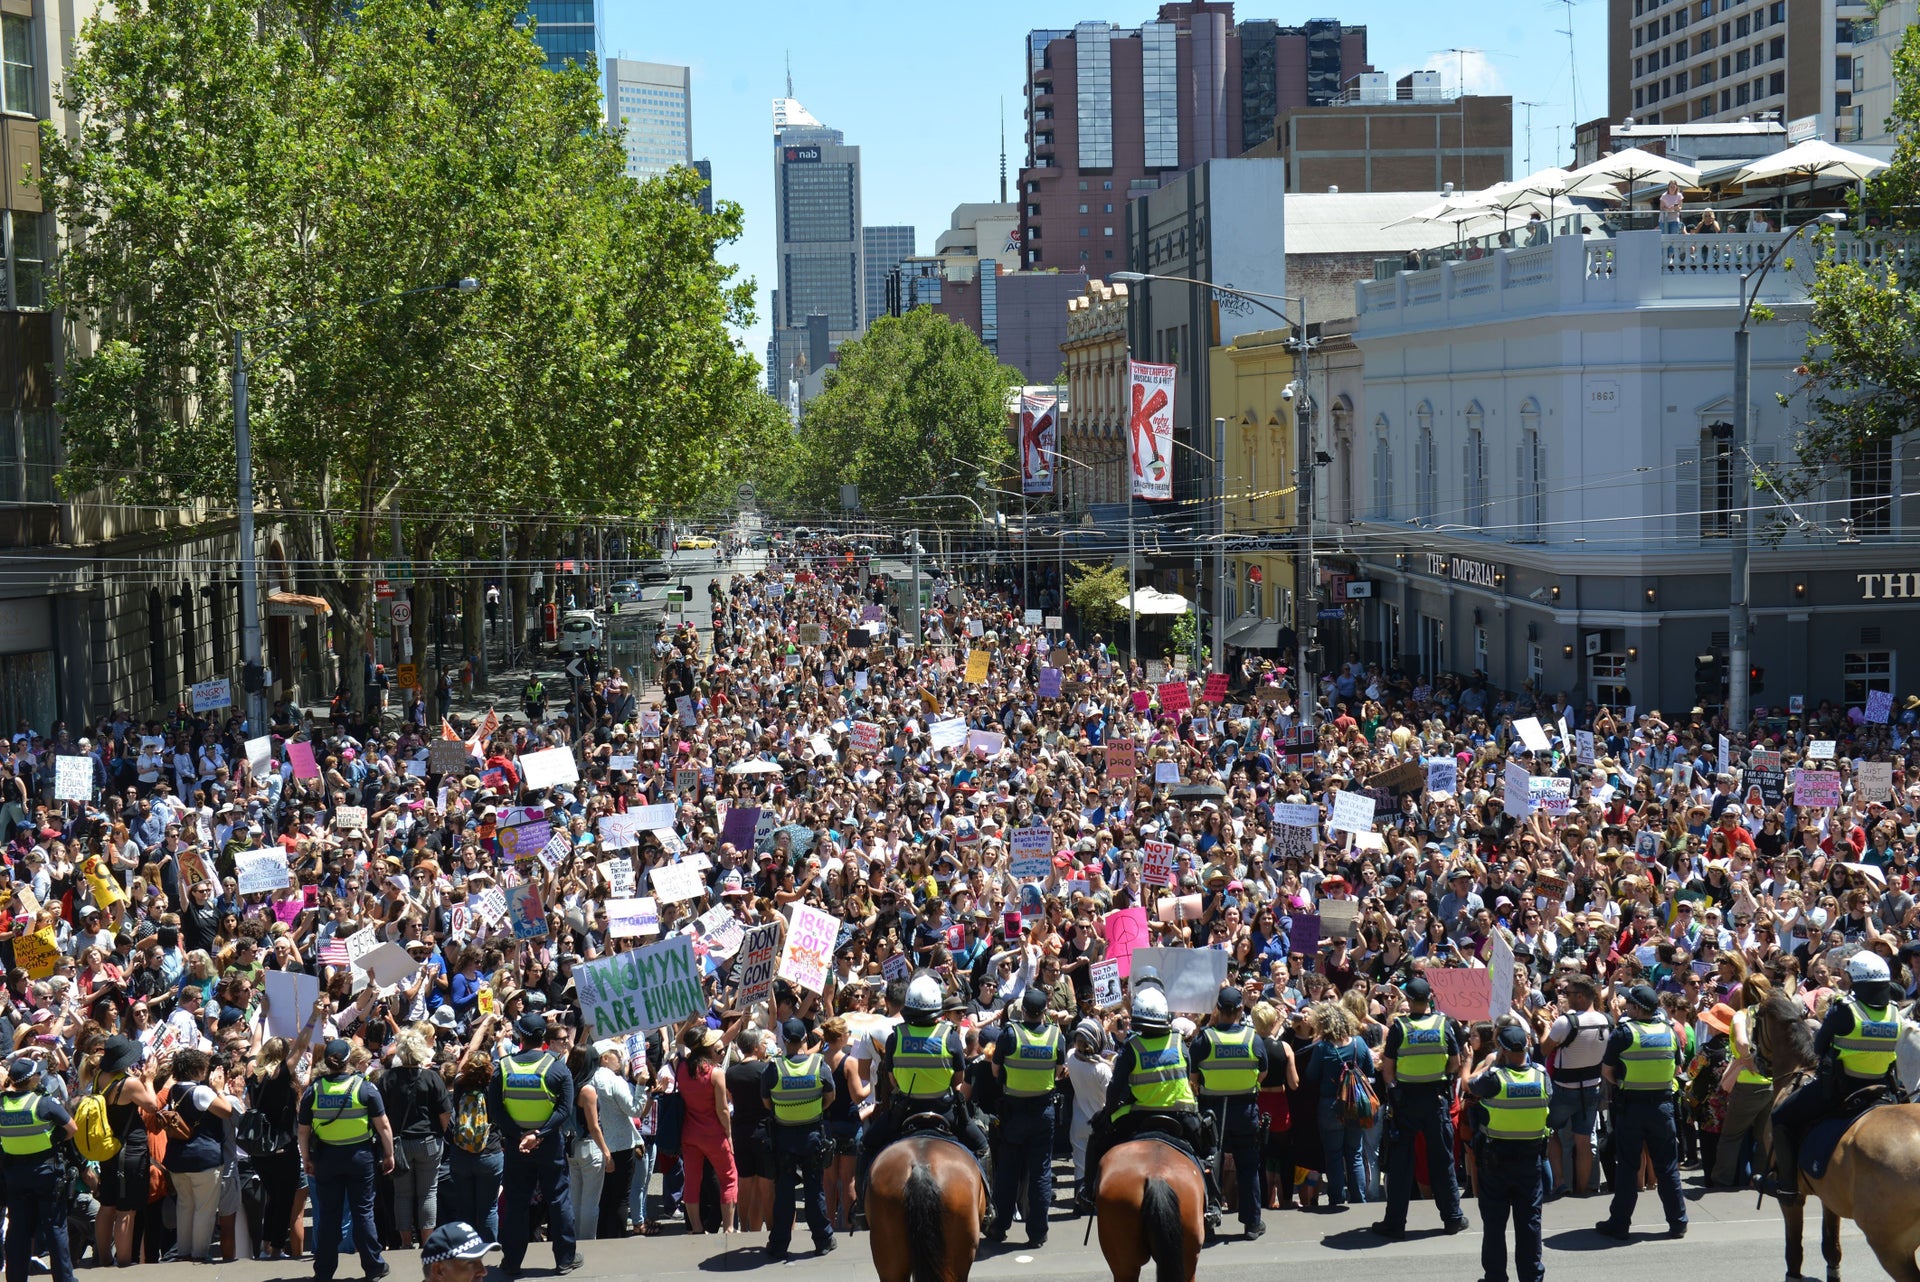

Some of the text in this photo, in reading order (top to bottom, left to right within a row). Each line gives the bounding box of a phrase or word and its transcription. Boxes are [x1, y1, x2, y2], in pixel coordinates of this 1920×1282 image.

[799, 150, 817, 159] nab
[1133, 374, 1152, 384] MUSICAL
[1153, 375, 1158, 384] IS
[1591, 391, 1615, 401] 1863
[395, 608, 409, 617] 40
[1319, 610, 1336, 619] Spring
[196, 686, 226, 697] ANGRY
[1109, 742, 1132, 751] PRO
[62, 761, 87, 771] MONEY
[1110, 758, 1132, 767] PRO
[1752, 758, 1779, 766] SILENT
[61, 778, 86, 788] EQUAL
[1747, 777, 1776, 789] THAN FEAR
[1757, 771, 1784, 783] STRONGER
[1803, 773, 1833, 782] RESPECT
[1528, 790, 1569, 799] ATRIARCHY
[1803, 789, 1829, 798] EXPECT
[1540, 798, 1570, 809] PUSSY!
[762, 812, 773, 820] UP
[1272, 821, 1286, 829] MY
[758, 828, 770, 836] UP
[553, 836, 567, 856] FUCK
[1145, 842, 1173, 854] NOT
[547, 844, 560, 861] TRUMP
[1146, 853, 1167, 864] MY
[1275, 847, 1313, 858] BACK
[1143, 863, 1170, 877] PREZ
[1542, 881, 1564, 892] NASTY
[491, 889, 507, 908] FUCK
[514, 925, 547, 938] NOPE
[711, 917, 736, 938] TRUMPS
[800, 911, 835, 941] 1848
[13, 934, 38, 945] GIRLS
[15, 938, 49, 951] WANT TO
[749, 925, 778, 953] DON
[793, 931, 829, 956] 2017
[748, 947, 776, 965] THE
[589, 944, 690, 1002] WOMYN
[743, 960, 771, 986] CON
[885, 962, 905, 974] RACISM
[1427, 969, 1486, 988] NOT MY
[741, 981, 768, 996] EXPECT
[642, 976, 706, 1024] HUMAN
[1096, 993, 1120, 1005] TRUMP!
[1436, 991, 1491, 1011] PUSSY
[594, 996, 640, 1036] ARE
[1862, 1023, 1896, 1037] Police
[1408, 1032, 1439, 1043] Police
[903, 1038, 939, 1052] Police
[1215, 1045, 1246, 1057] Police
[1021, 1047, 1052, 1058] Police
[1142, 1050, 1178, 1067] Police
[508, 1077, 539, 1087] Police
[782, 1077, 815, 1089] Police
[1508, 1085, 1541, 1096] Police
[319, 1096, 352, 1108] Police
[1, 1112, 31, 1125] Police
